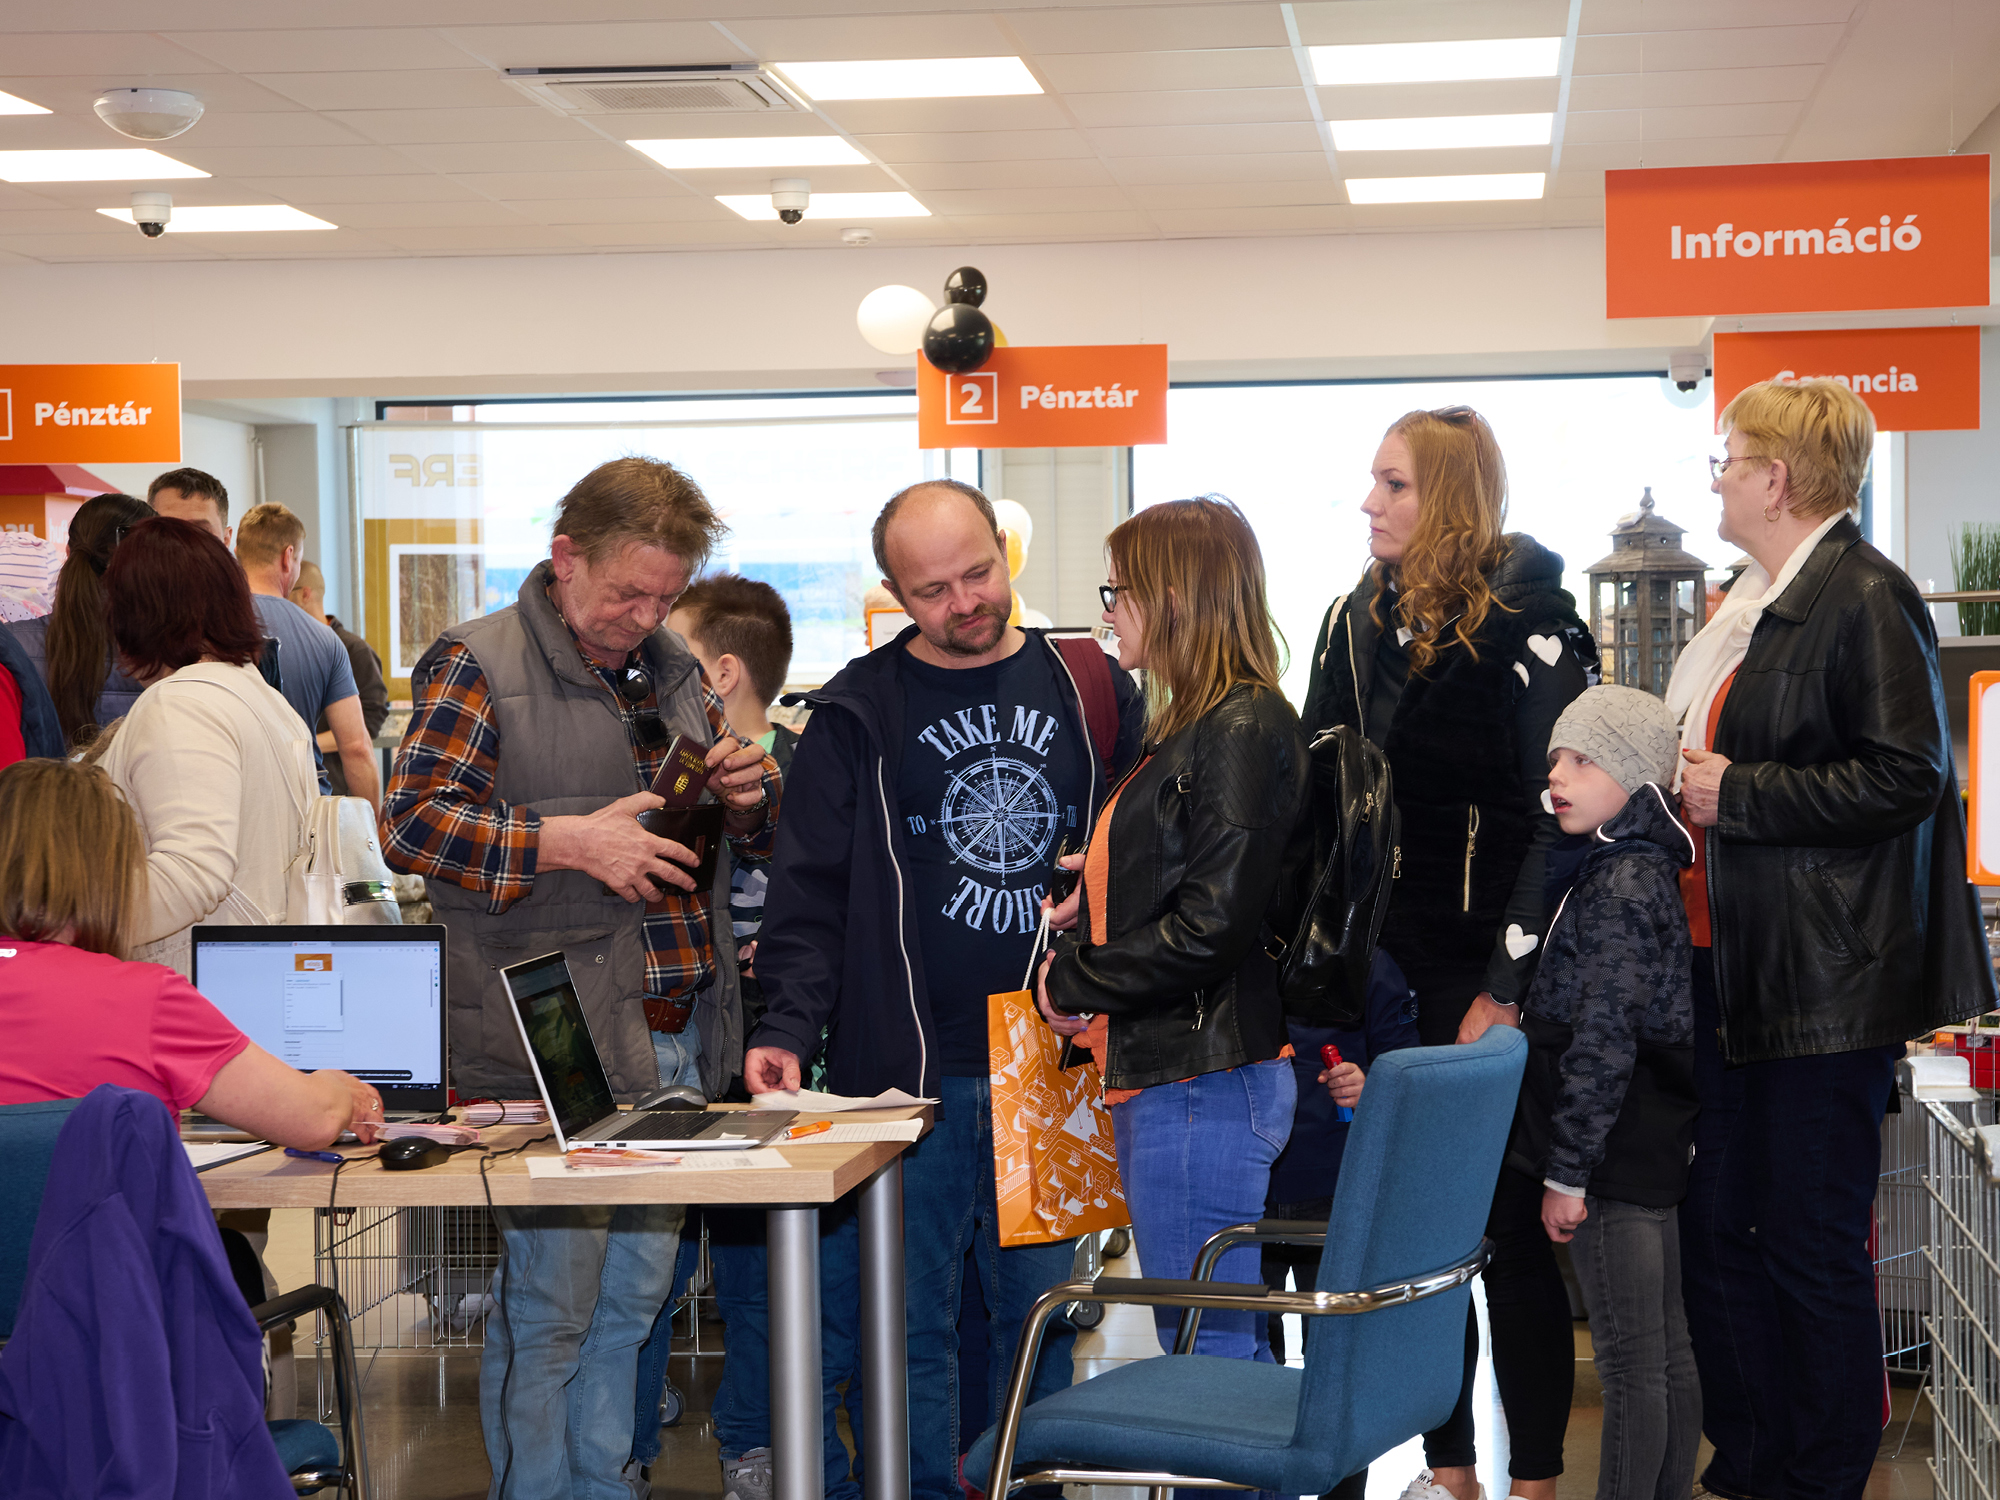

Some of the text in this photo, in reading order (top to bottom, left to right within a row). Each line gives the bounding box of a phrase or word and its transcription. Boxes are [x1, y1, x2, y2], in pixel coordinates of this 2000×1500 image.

[1671, 214, 1922, 260] Információ
[34, 401, 152, 426] Pénztár
[960, 383, 1139, 414] 2 Pénztár
[917, 704, 1059, 761] TAKE ME
[906, 815, 926, 835] TO
